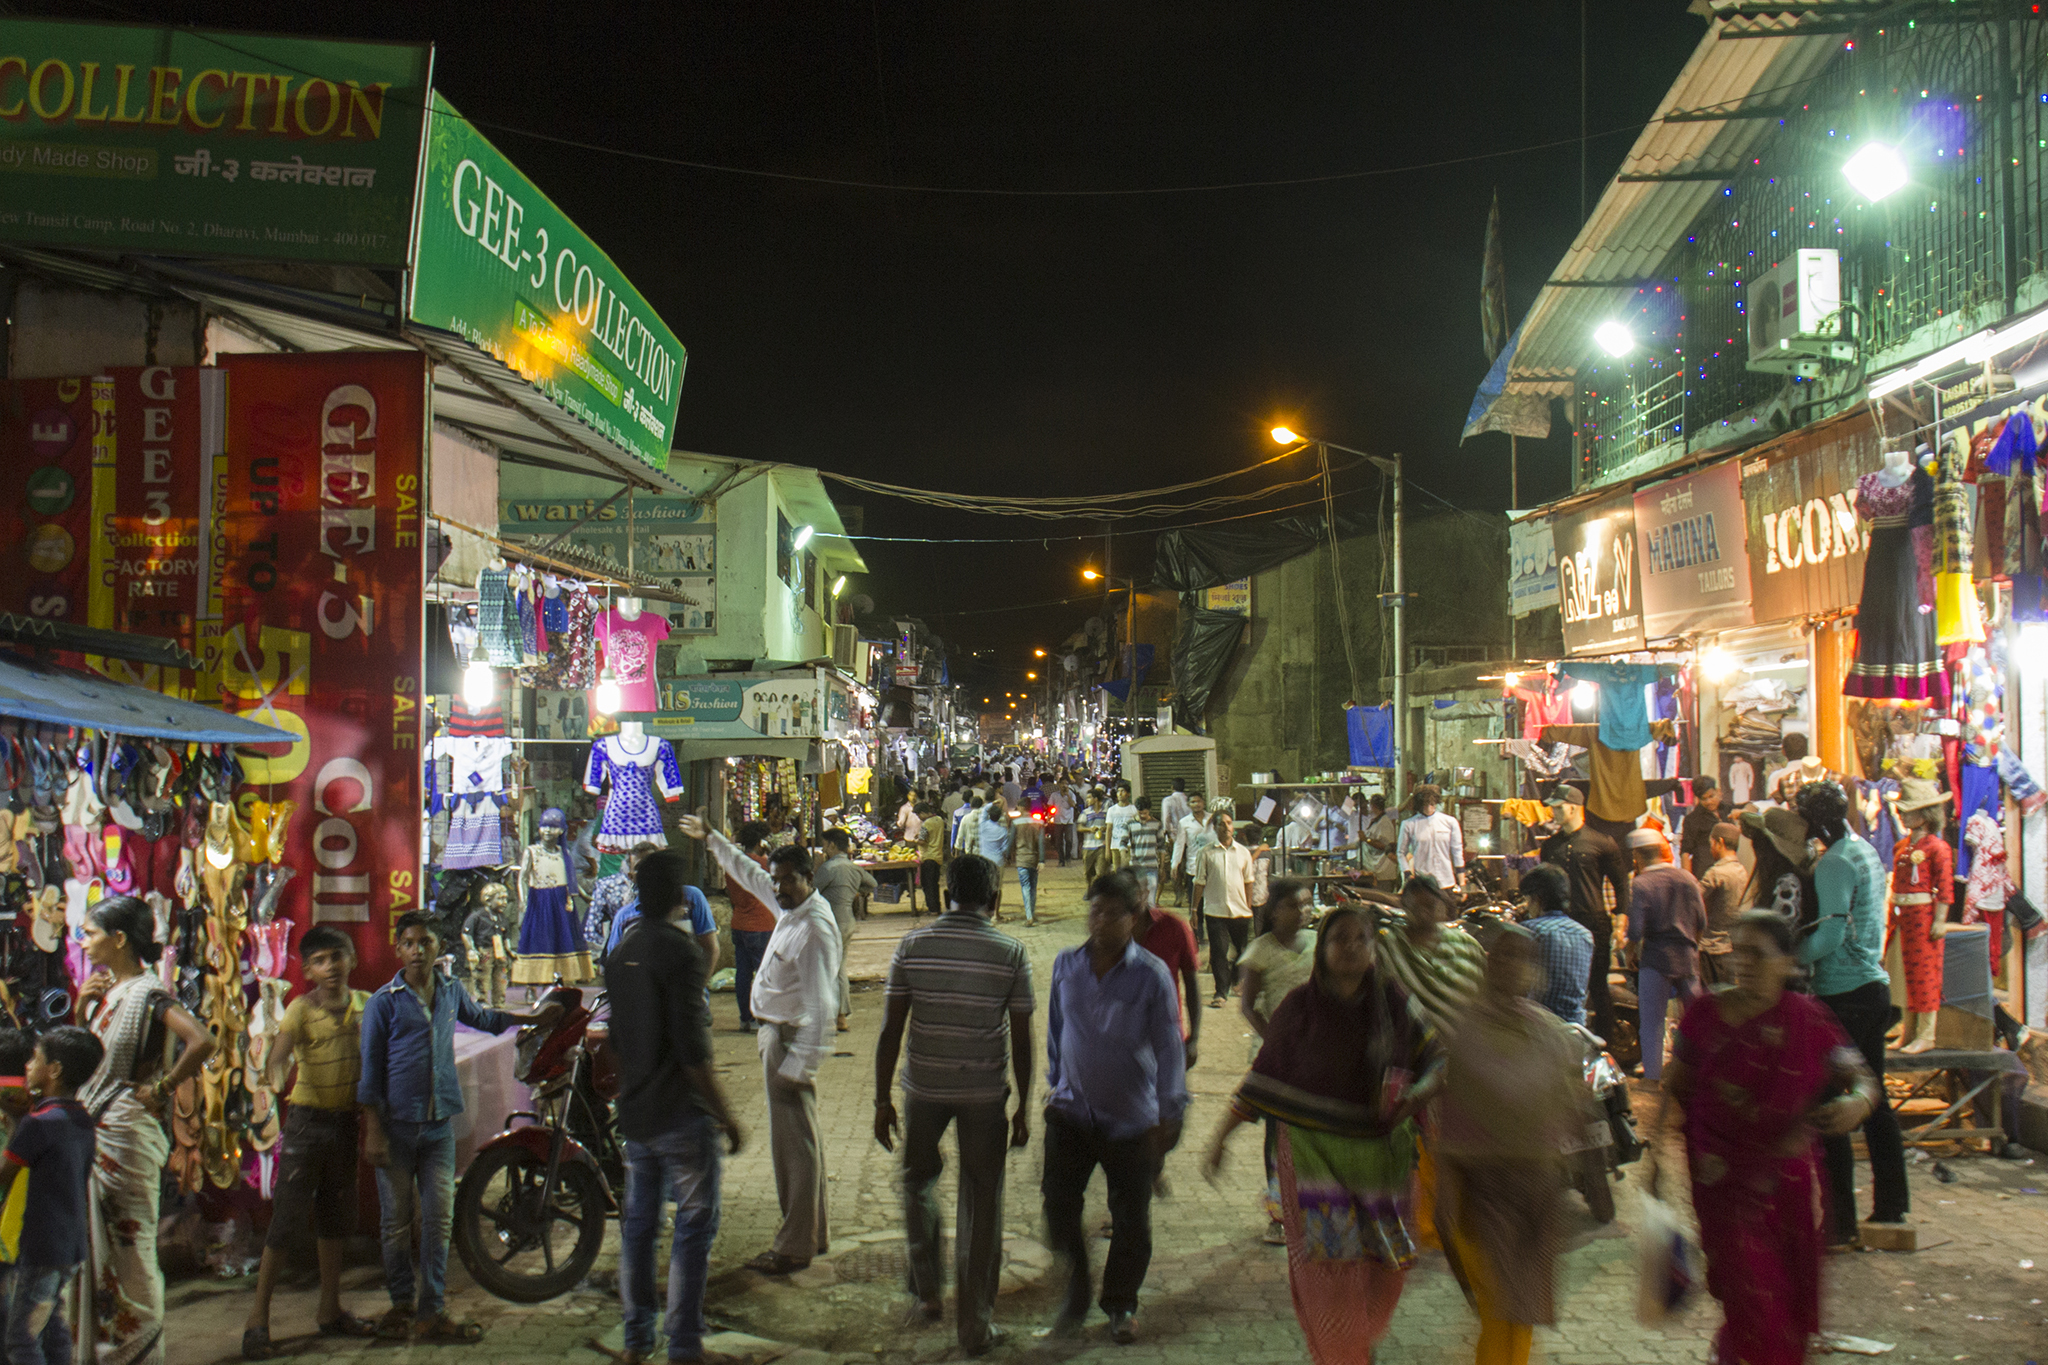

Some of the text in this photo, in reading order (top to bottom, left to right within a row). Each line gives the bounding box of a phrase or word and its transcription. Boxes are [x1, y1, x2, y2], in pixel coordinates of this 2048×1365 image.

[0, 56, 392, 139] COLLECTION
[33, 147, 89, 168] Made
[96, 151, 150, 175] Shop
[26, 211, 69, 229] Transit
[120, 217, 155, 232] Road
[264, 227, 319, 245] Mumbai
[452, 159, 676, 407] GEE-3 COLLECTION
[604, 373, 619, 401] Shop
[247, 456, 280, 593] UP TO
[318, 384, 377, 640] GEE-3
[395, 473, 418, 548] SALE
[514, 499, 618, 522] waris
[1763, 488, 1872, 575] ICON
[1646, 511, 1721, 575] MADINA
[128, 580, 179, 598] RATE
[1698, 566, 1735, 593] TAILORS
[393, 675, 416, 751] SALE
[691, 697, 739, 710] Fashion
